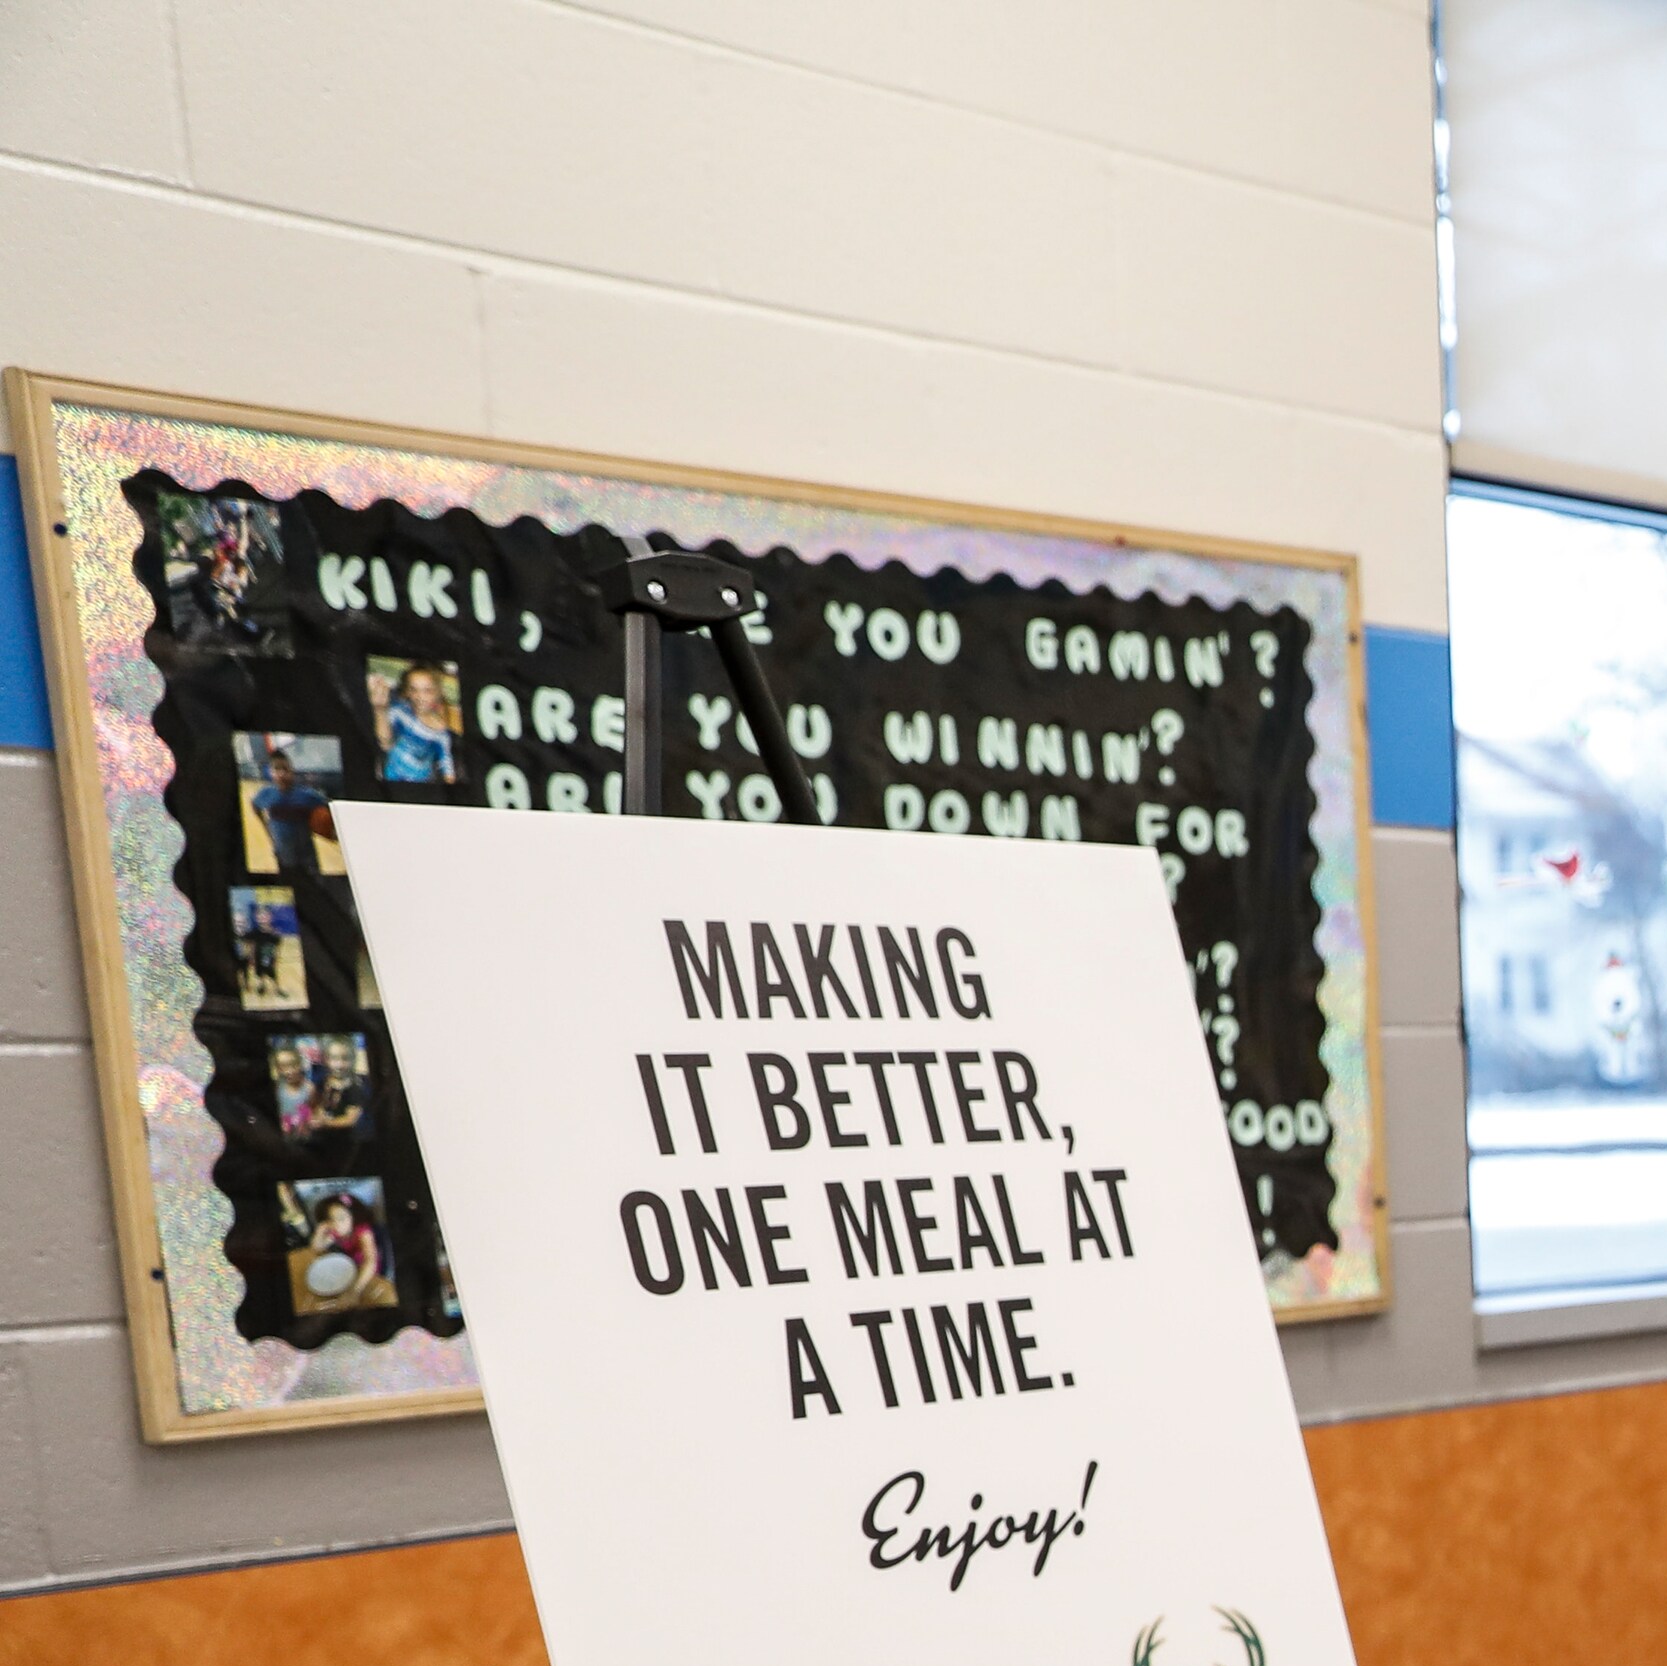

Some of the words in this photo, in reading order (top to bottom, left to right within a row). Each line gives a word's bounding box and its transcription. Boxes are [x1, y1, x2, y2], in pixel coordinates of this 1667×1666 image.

[318, 553, 542, 653] KIKI,
[824, 600, 961, 665] YOU
[884, 783, 1082, 841] DOWN
[1135, 800, 1249, 858] FOR
[662, 919, 992, 1020] MAKING
[634, 1052, 719, 1156] IT
[746, 1050, 1076, 1155] BETTER,
[1222, 1098, 1331, 1152] OOD
[619, 1185, 810, 1296] ONE
[823, 1174, 1045, 1279] MEAL
[1063, 1168, 1135, 1262] AT
[784, 1317, 843, 1420] A
[849, 1297, 1076, 1409] TIME.
[861, 1460, 1098, 1592] Enjoy!
